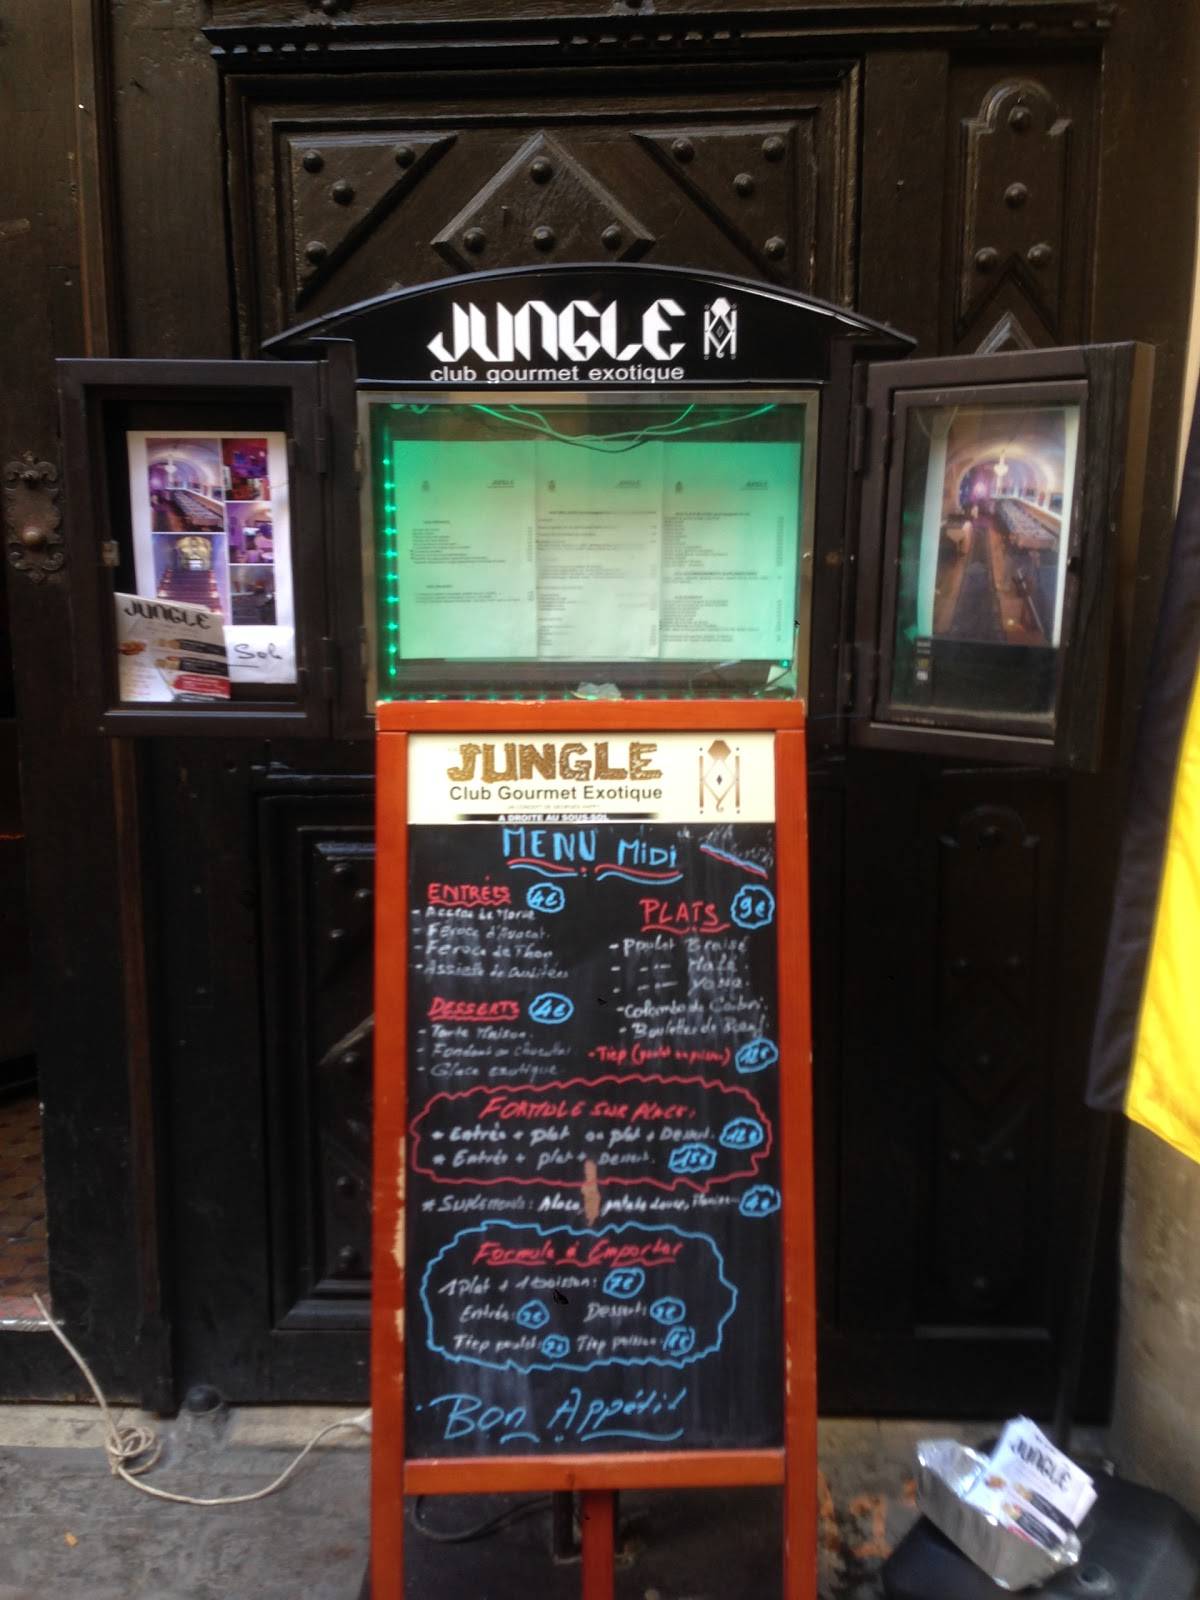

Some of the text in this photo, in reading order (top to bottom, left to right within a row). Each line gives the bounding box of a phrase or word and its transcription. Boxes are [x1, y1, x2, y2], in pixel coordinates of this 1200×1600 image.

[427, 299, 686, 362] JUNGLE
[430, 364, 685, 383] club gourmet exotique
[123, 601, 210, 630] JUNGLE
[447, 741, 663, 783] JUNGLE
[450, 785, 663, 802] Club Gourmet Exotique
[498, 814, 506, 823] A
[507, 814, 544, 823] DROITE
[546, 814, 559, 823] AU
[502, 826, 598, 862] MENU
[640, 897, 720, 927] PLATS
[514, 943, 554, 958] Thon
[428, 1392, 527, 1440] Bon
[1009, 1438, 1071, 1491] JUNGLE
